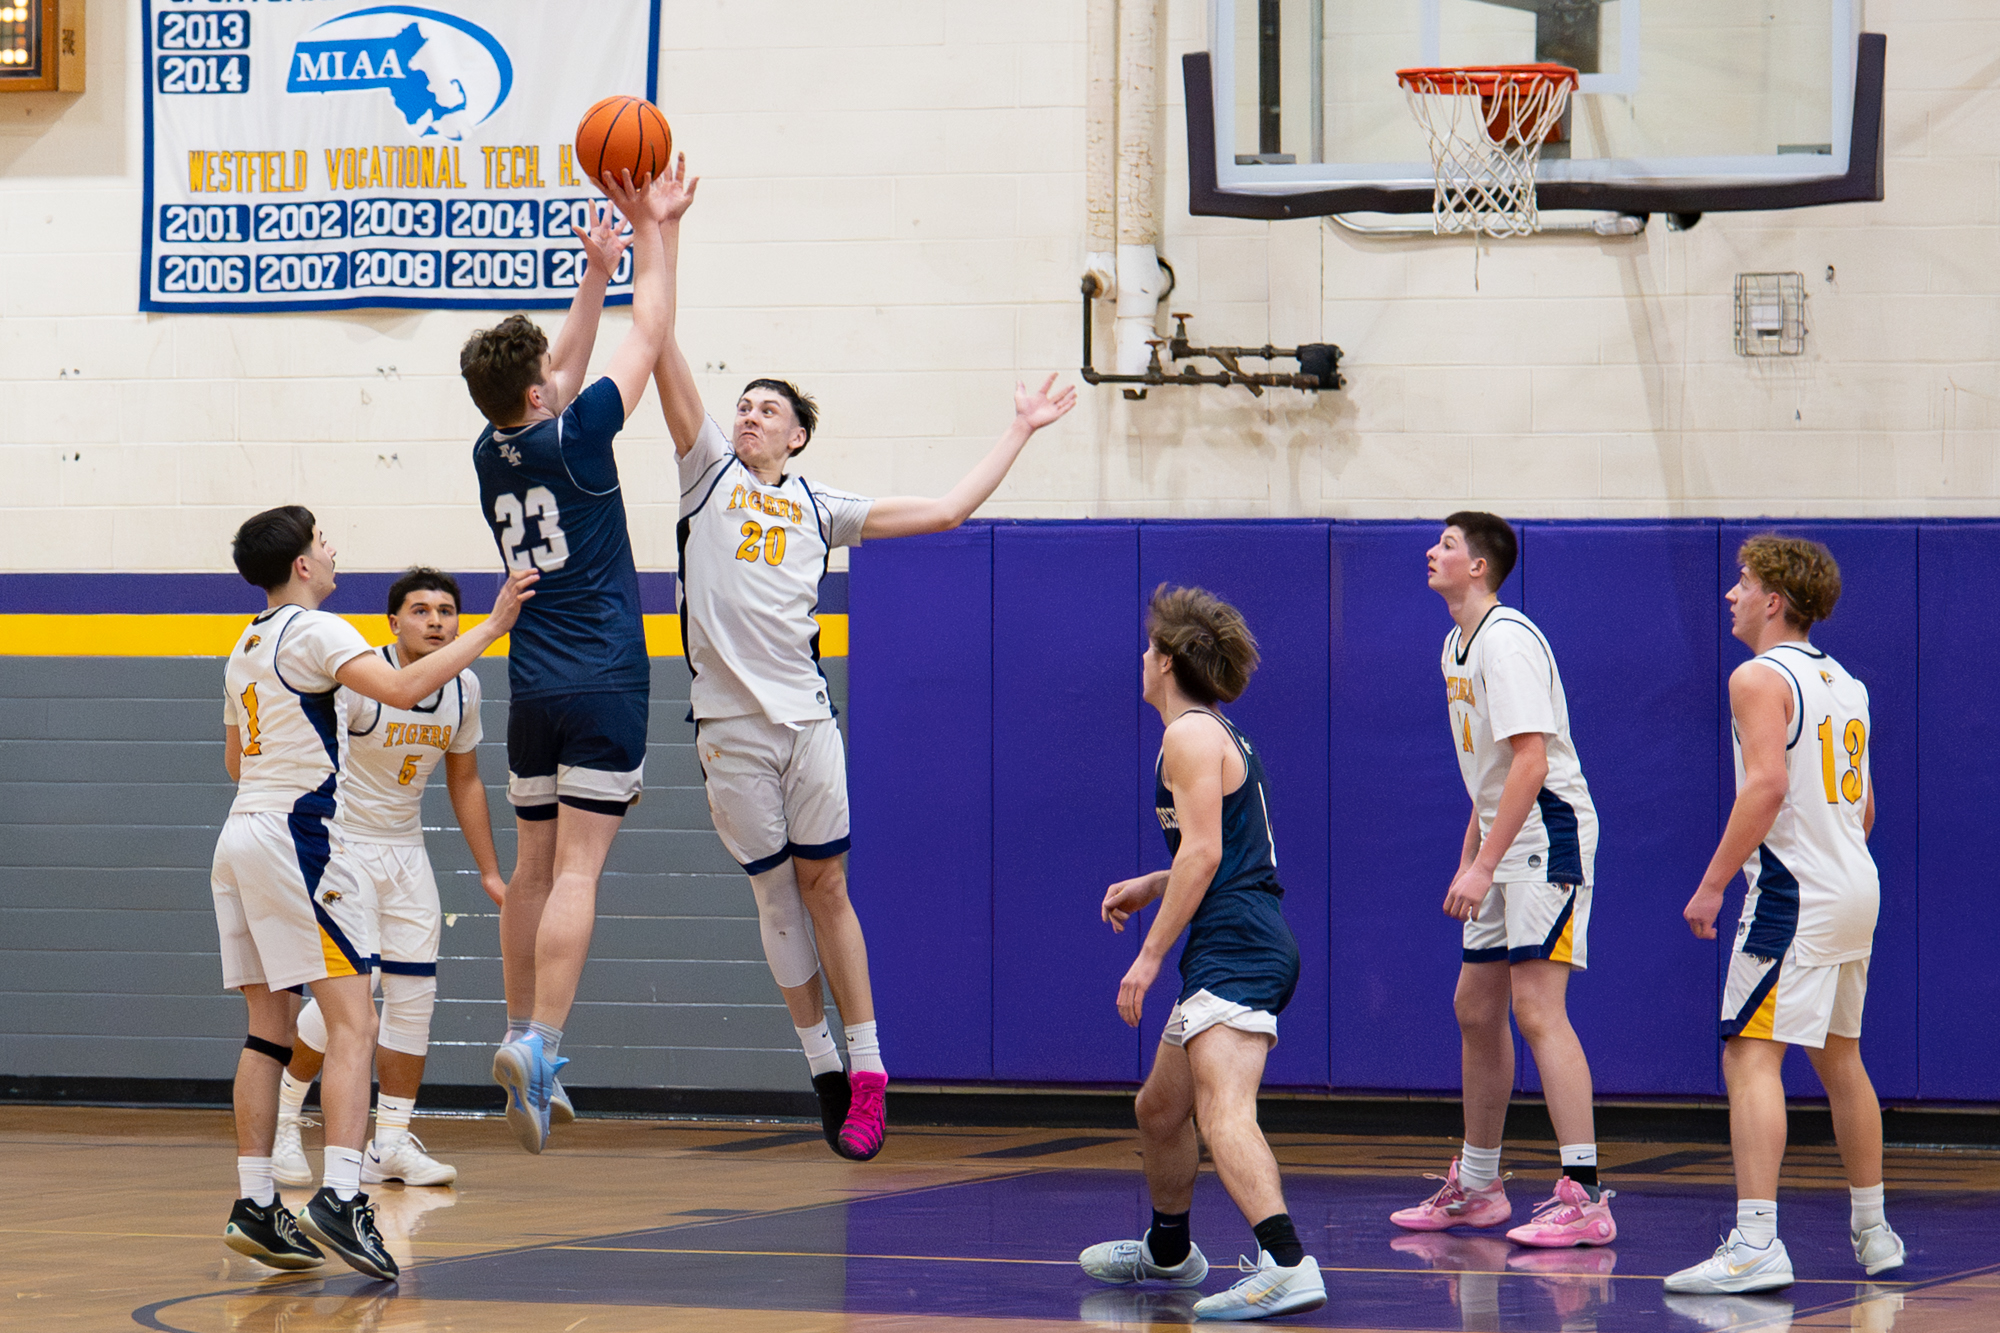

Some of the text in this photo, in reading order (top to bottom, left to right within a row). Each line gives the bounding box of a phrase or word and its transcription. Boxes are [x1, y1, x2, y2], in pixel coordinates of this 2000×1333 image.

[163, 13, 244, 48] 2013
[163, 57, 242, 92] 2014
[296, 48, 407, 82] MIAA
[188, 150, 307, 192] WESTFIELD
[325, 145, 467, 190] VOCATIONAL
[481, 145, 546, 188] TECH.
[166, 206, 242, 241] 2001
[258, 203, 342, 240] 2002
[354, 201, 436, 236] 2003
[451, 201, 535, 237] 2004
[165, 256, 244, 291] 2006
[259, 254, 341, 290] 2007
[355, 251, 436, 287] 2008
[452, 252, 535, 287] 2009
[494, 485, 570, 573] 23
[735, 520, 787, 567] 20
[240, 681, 263, 757] 1
[383, 722, 452, 751] TIGERS
[397, 754, 423, 785] 5
[1817, 714, 1866, 805] 13
